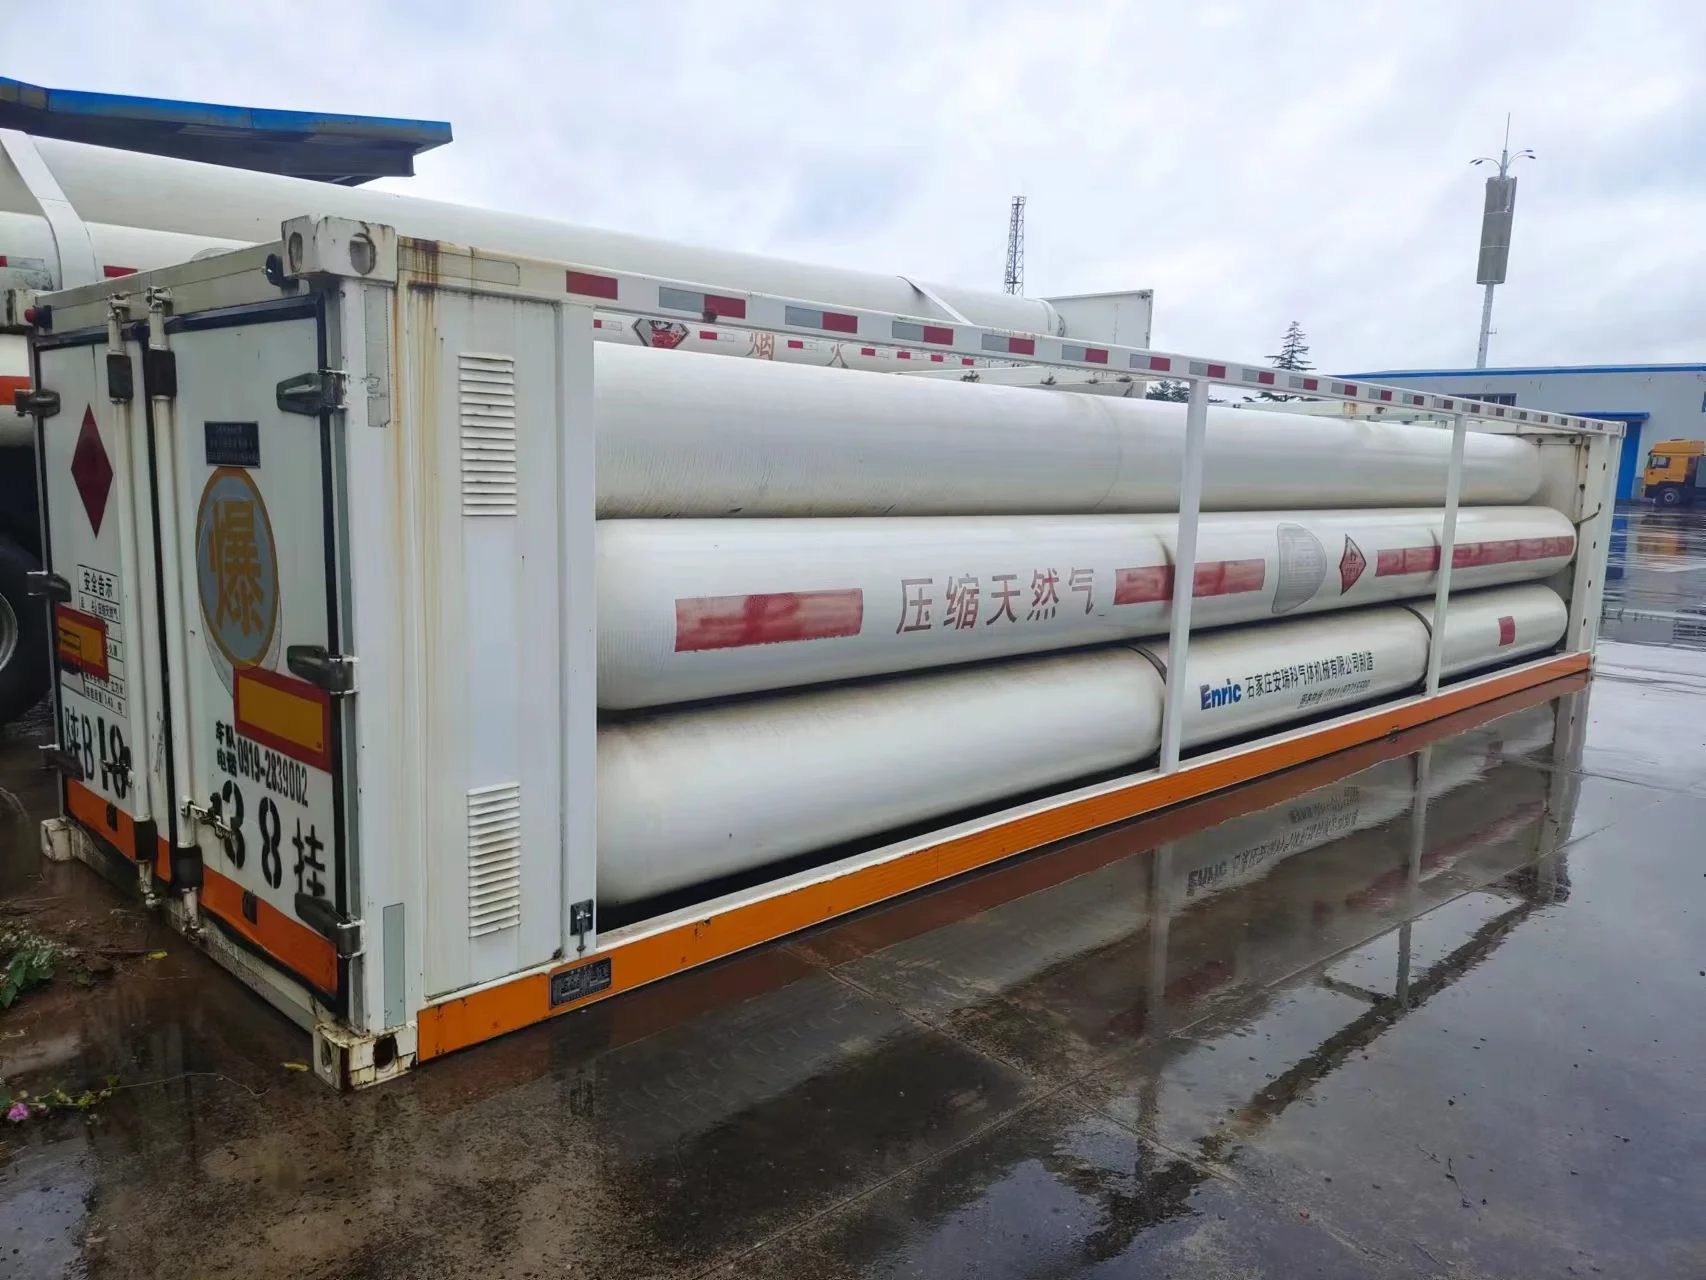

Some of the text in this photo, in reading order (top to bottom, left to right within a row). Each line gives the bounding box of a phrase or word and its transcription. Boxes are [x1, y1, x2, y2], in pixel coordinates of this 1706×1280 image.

[84, 570, 112, 598] 安全告示
[896, 567, 1094, 635] 压缩天然气
[1200, 678, 1242, 710] Enric
[1245, 651, 1373, 699] 石家庄安瑞科气体机械有限公司制造
[215, 719, 236, 749] 车队
[217, 736, 309, 808] 电话 0919-2839002
